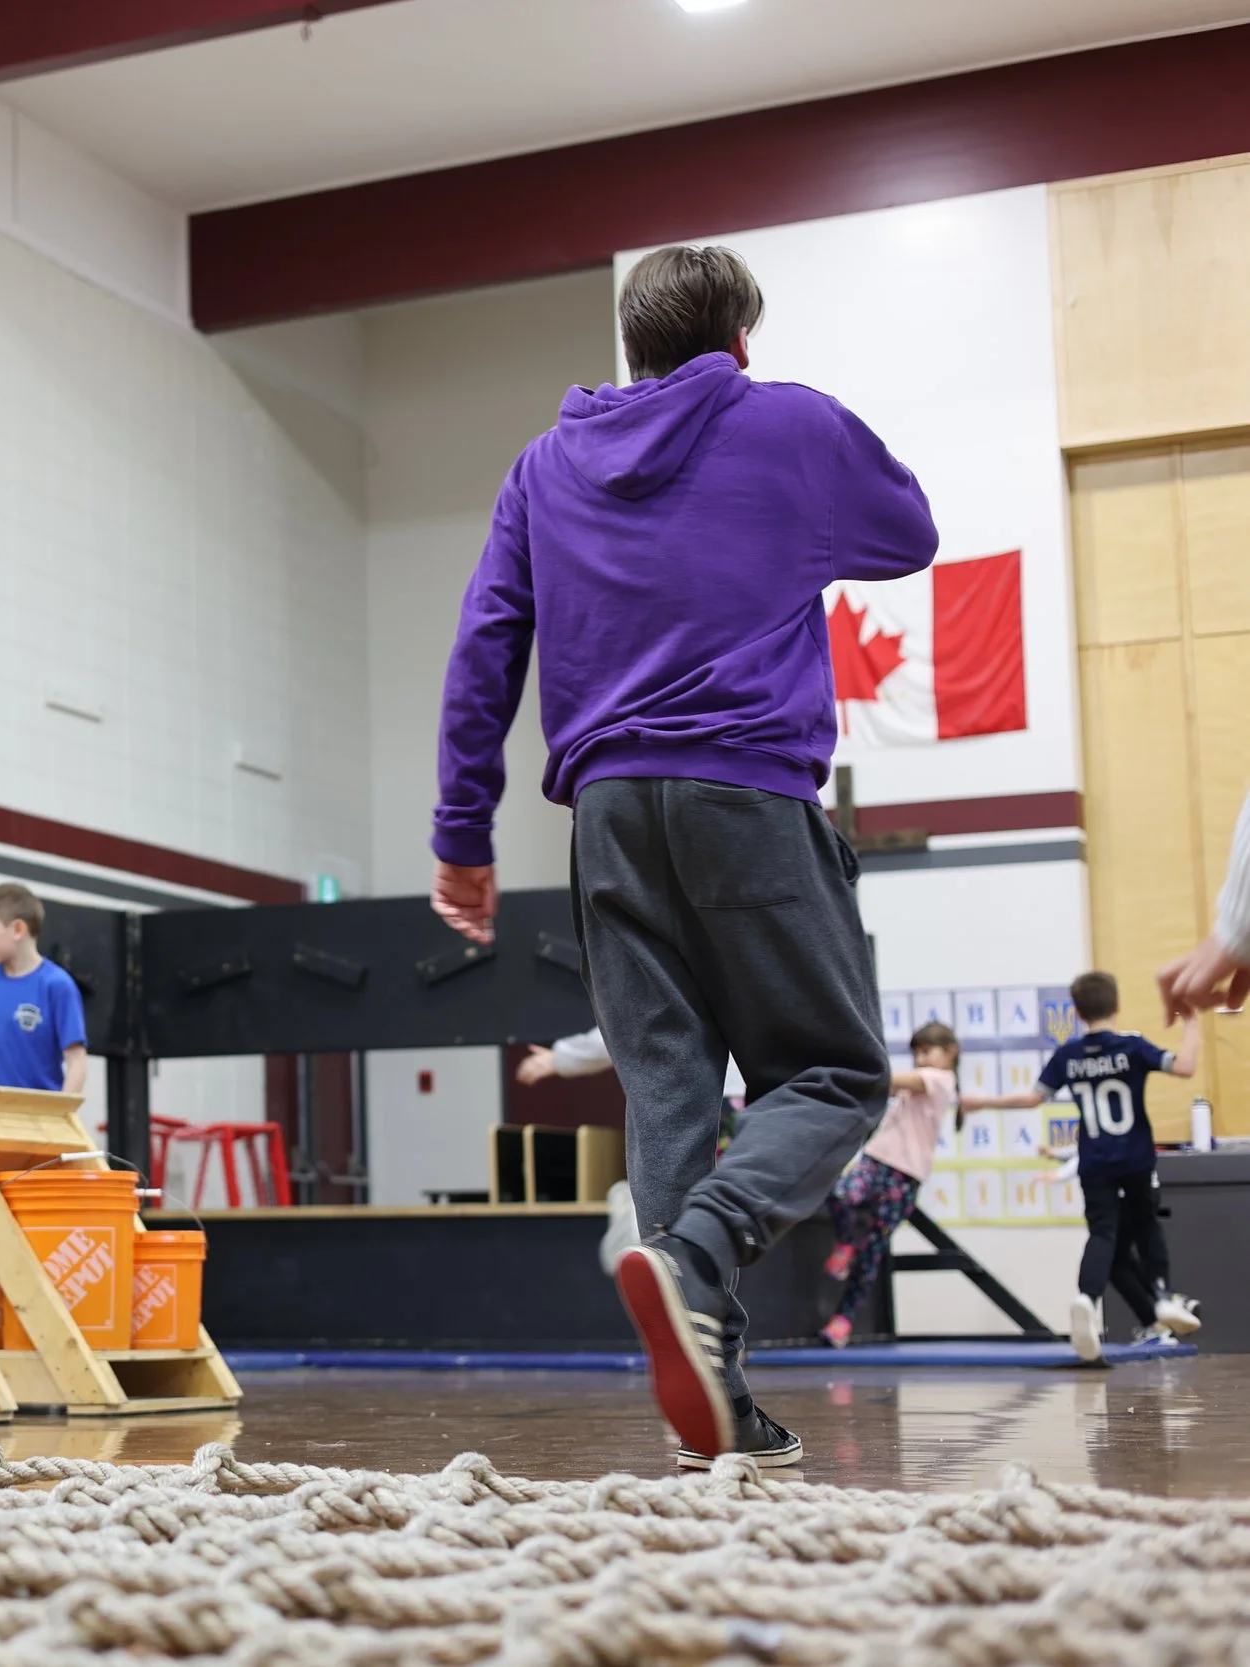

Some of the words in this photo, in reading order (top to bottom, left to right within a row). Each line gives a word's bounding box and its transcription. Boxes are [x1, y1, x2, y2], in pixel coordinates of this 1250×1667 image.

[1071, 1079, 1135, 1139] 10
[41, 1227, 95, 1284] OME
[59, 1241, 114, 1312] EPOT
[134, 1275, 177, 1335] EPOT
